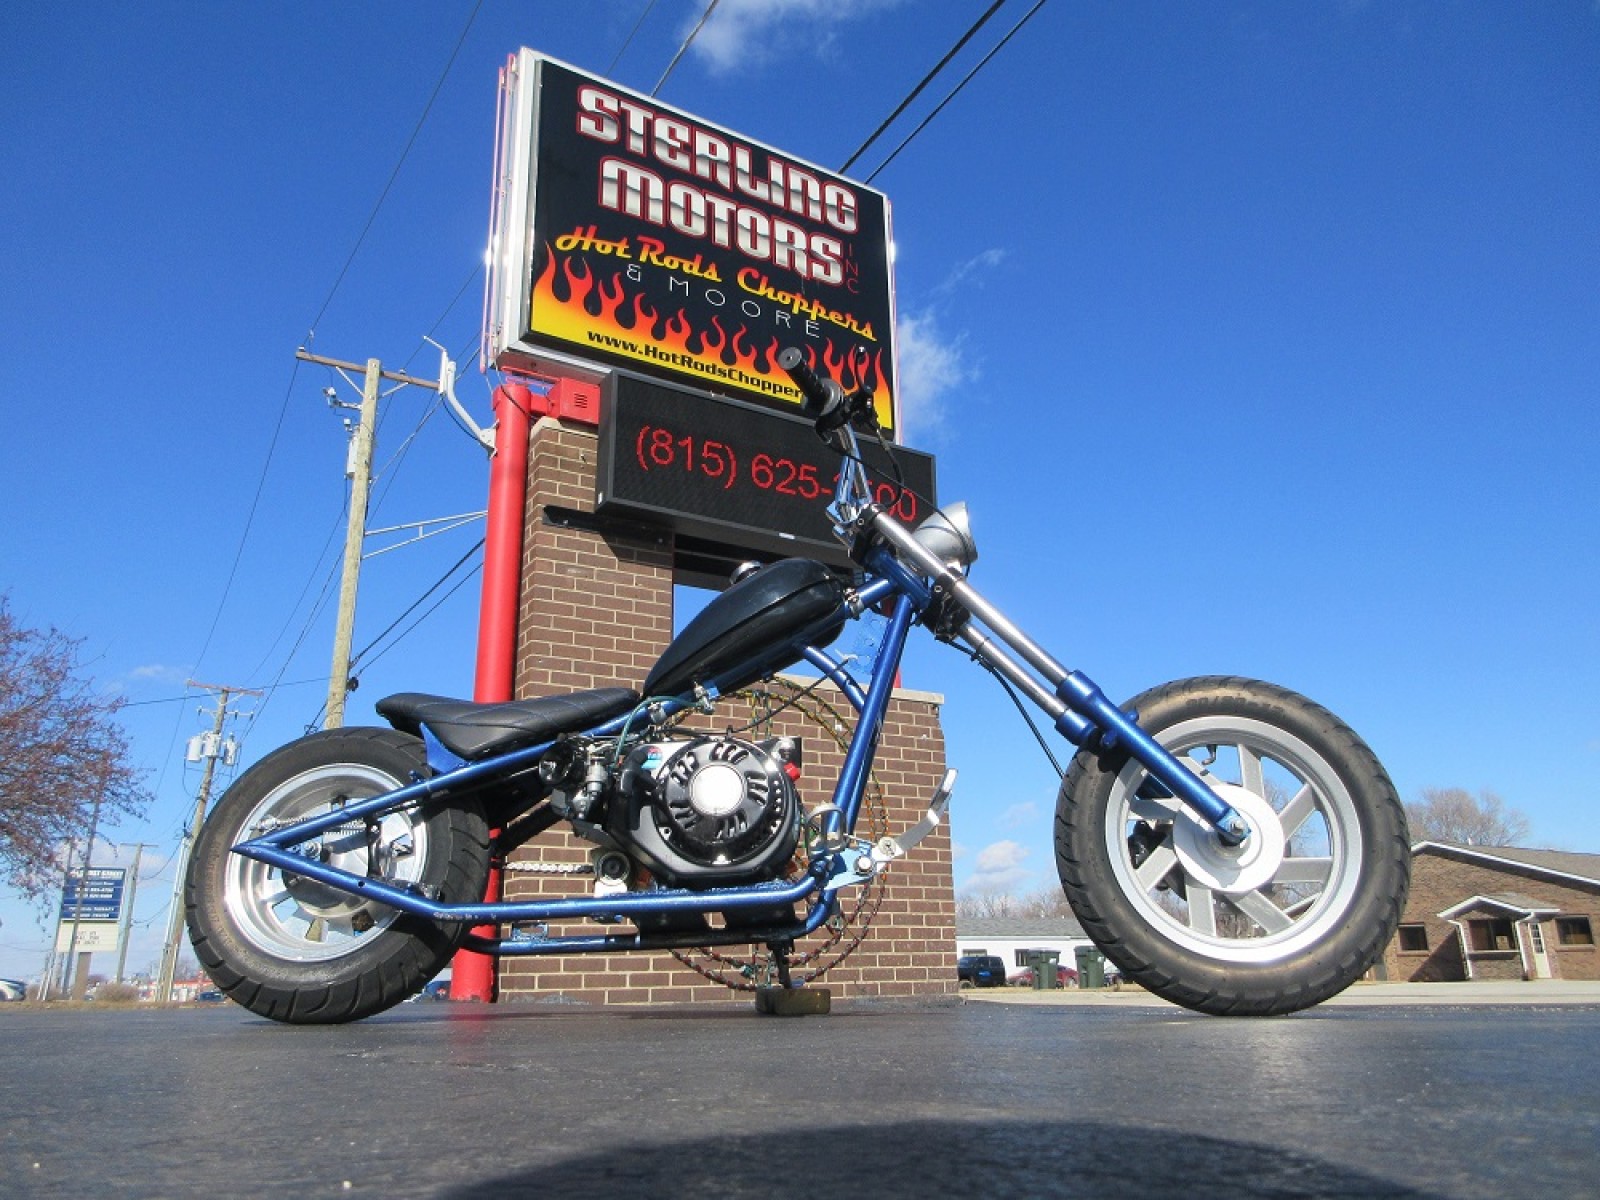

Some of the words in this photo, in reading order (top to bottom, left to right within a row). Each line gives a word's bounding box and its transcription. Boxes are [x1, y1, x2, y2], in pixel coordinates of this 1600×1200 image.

[577, 85, 858, 234] STERLING
[598, 155, 846, 286] MOTORS
[846, 242, 859, 295] INC
[555, 225, 633, 258] Hot
[636, 236, 723, 283] Rods
[737, 267, 877, 342] Choppers
[625, 263, 642, 283] &
[668, 276, 820, 338] MOORE
[586, 329, 803, 398] www.HotRodsChopper
[636, 424, 738, 490] (815)
[751, 453, 917, 523] 625-00
